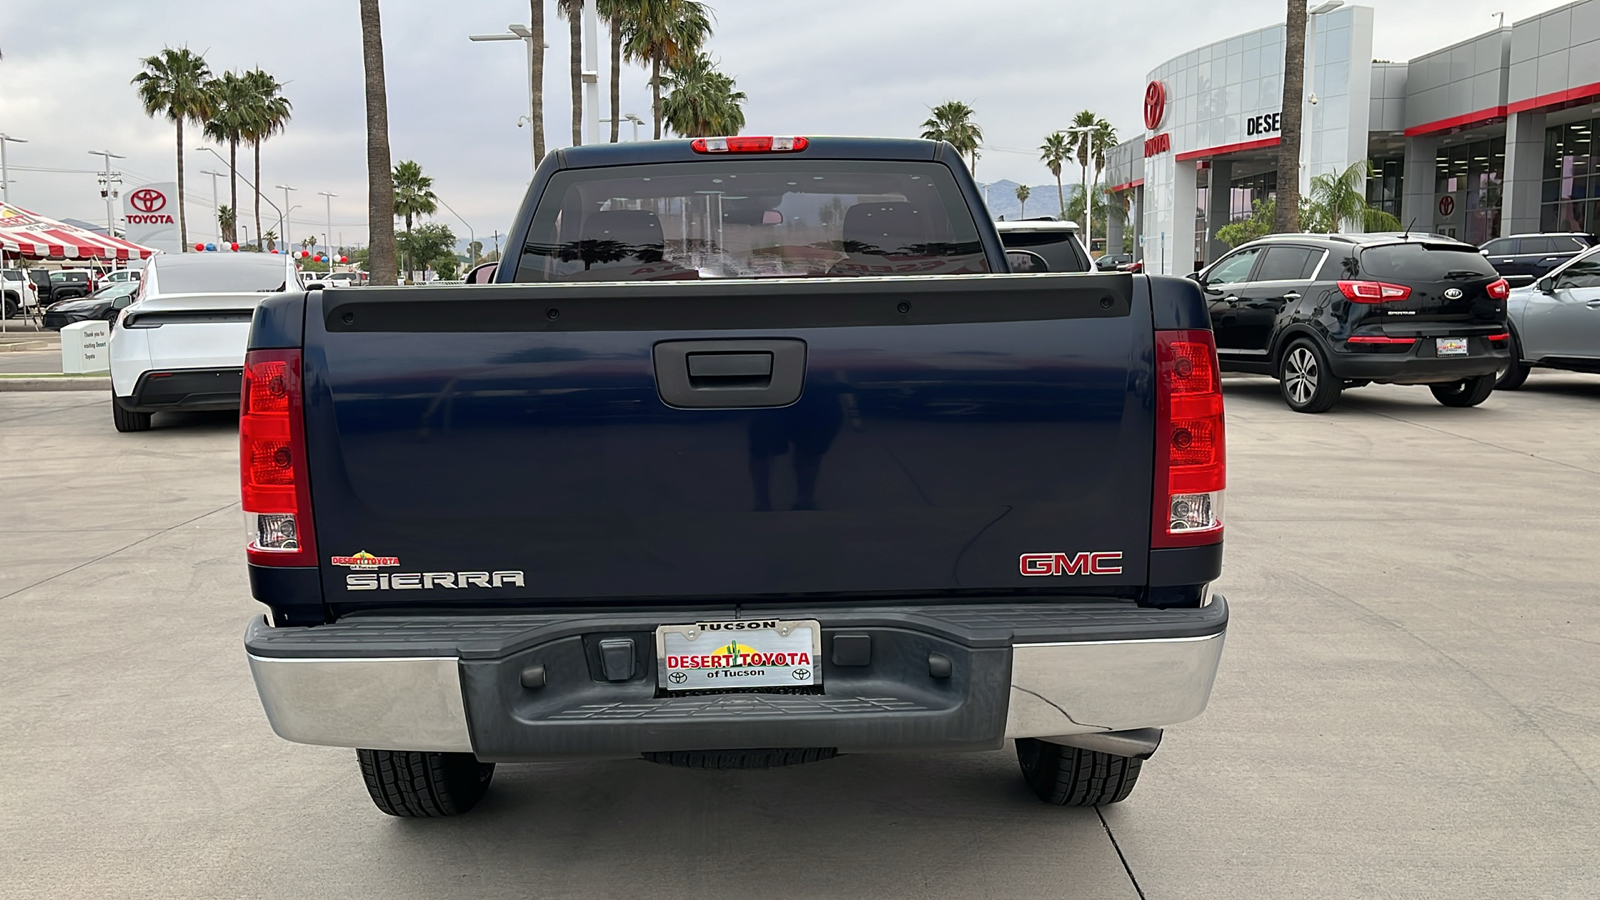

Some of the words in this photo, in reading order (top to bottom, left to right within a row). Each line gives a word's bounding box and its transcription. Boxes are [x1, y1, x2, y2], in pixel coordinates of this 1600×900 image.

[125, 214, 174, 224] TOYOTA
[365, 557, 399, 565] TOYOTA
[1020, 551, 1123, 576] GMC
[346, 571, 525, 591] SIERRA
[698, 621, 776, 631] TUCSON
[667, 654, 733, 669] DESERT
[739, 652, 811, 666] TOYOTA
[722, 669, 765, 678] Tucson
